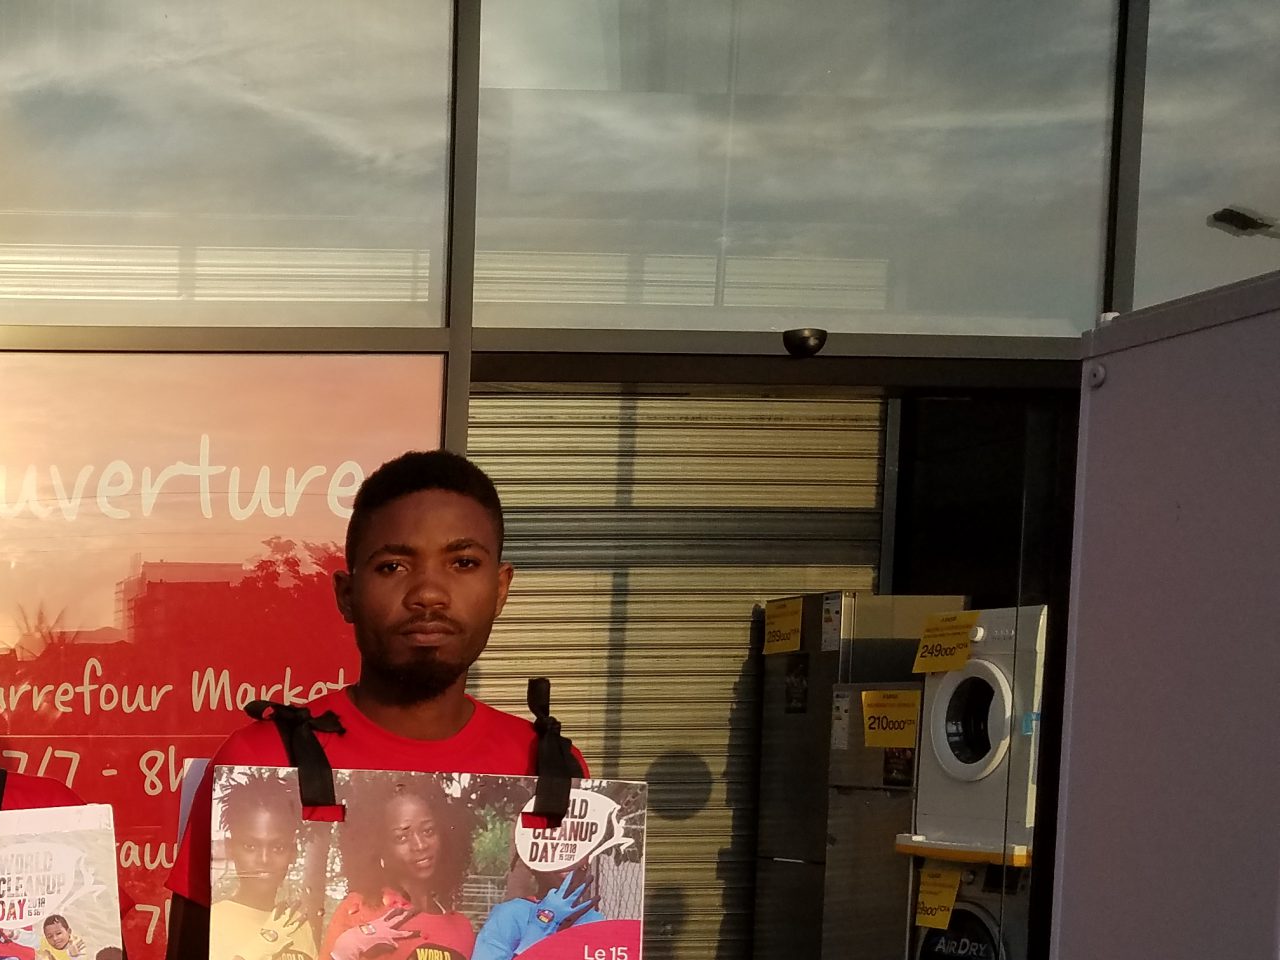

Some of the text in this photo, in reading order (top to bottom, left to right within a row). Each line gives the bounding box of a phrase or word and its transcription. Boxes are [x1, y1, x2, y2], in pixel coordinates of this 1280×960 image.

[920, 643, 956, 658] 249000
[868, 715, 905, 731] 210000
[529, 842, 559, 862] DAY
[584, 945, 606, 960] Le
